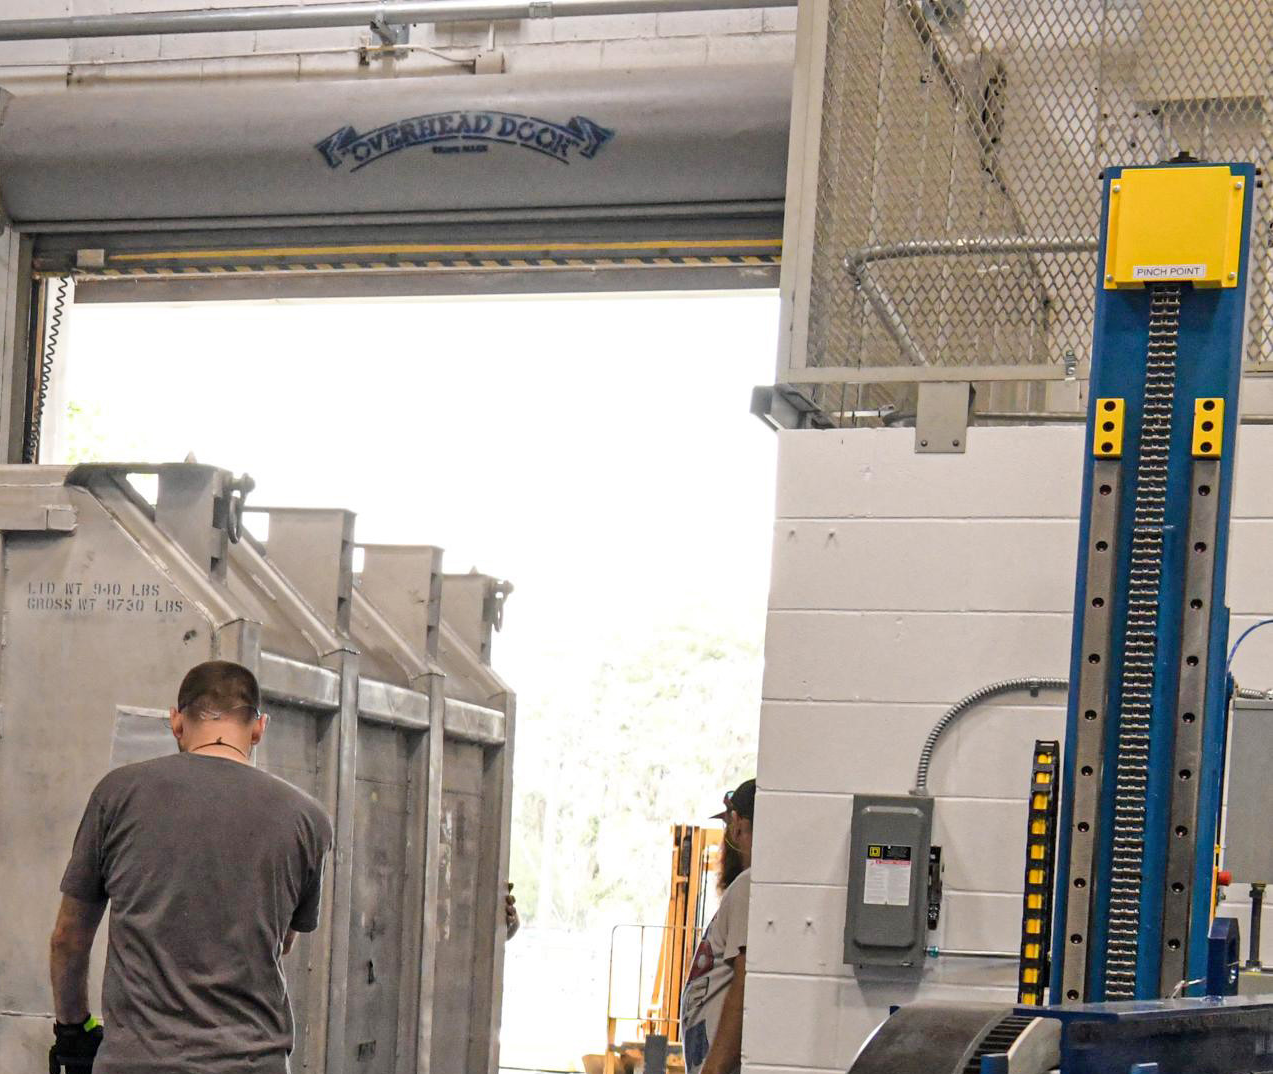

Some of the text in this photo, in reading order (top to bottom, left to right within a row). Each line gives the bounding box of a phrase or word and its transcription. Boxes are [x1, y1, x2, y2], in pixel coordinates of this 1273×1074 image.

[352, 113, 575, 163] OVERHEAD DOOR
[1136, 267, 1201, 277] PINCH POINT
[28, 581, 55, 594] LID
[65, 582, 83, 595] WT
[132, 583, 160, 597] LBS
[27, 598, 183, 613] GROSS WT 9730 LBS
